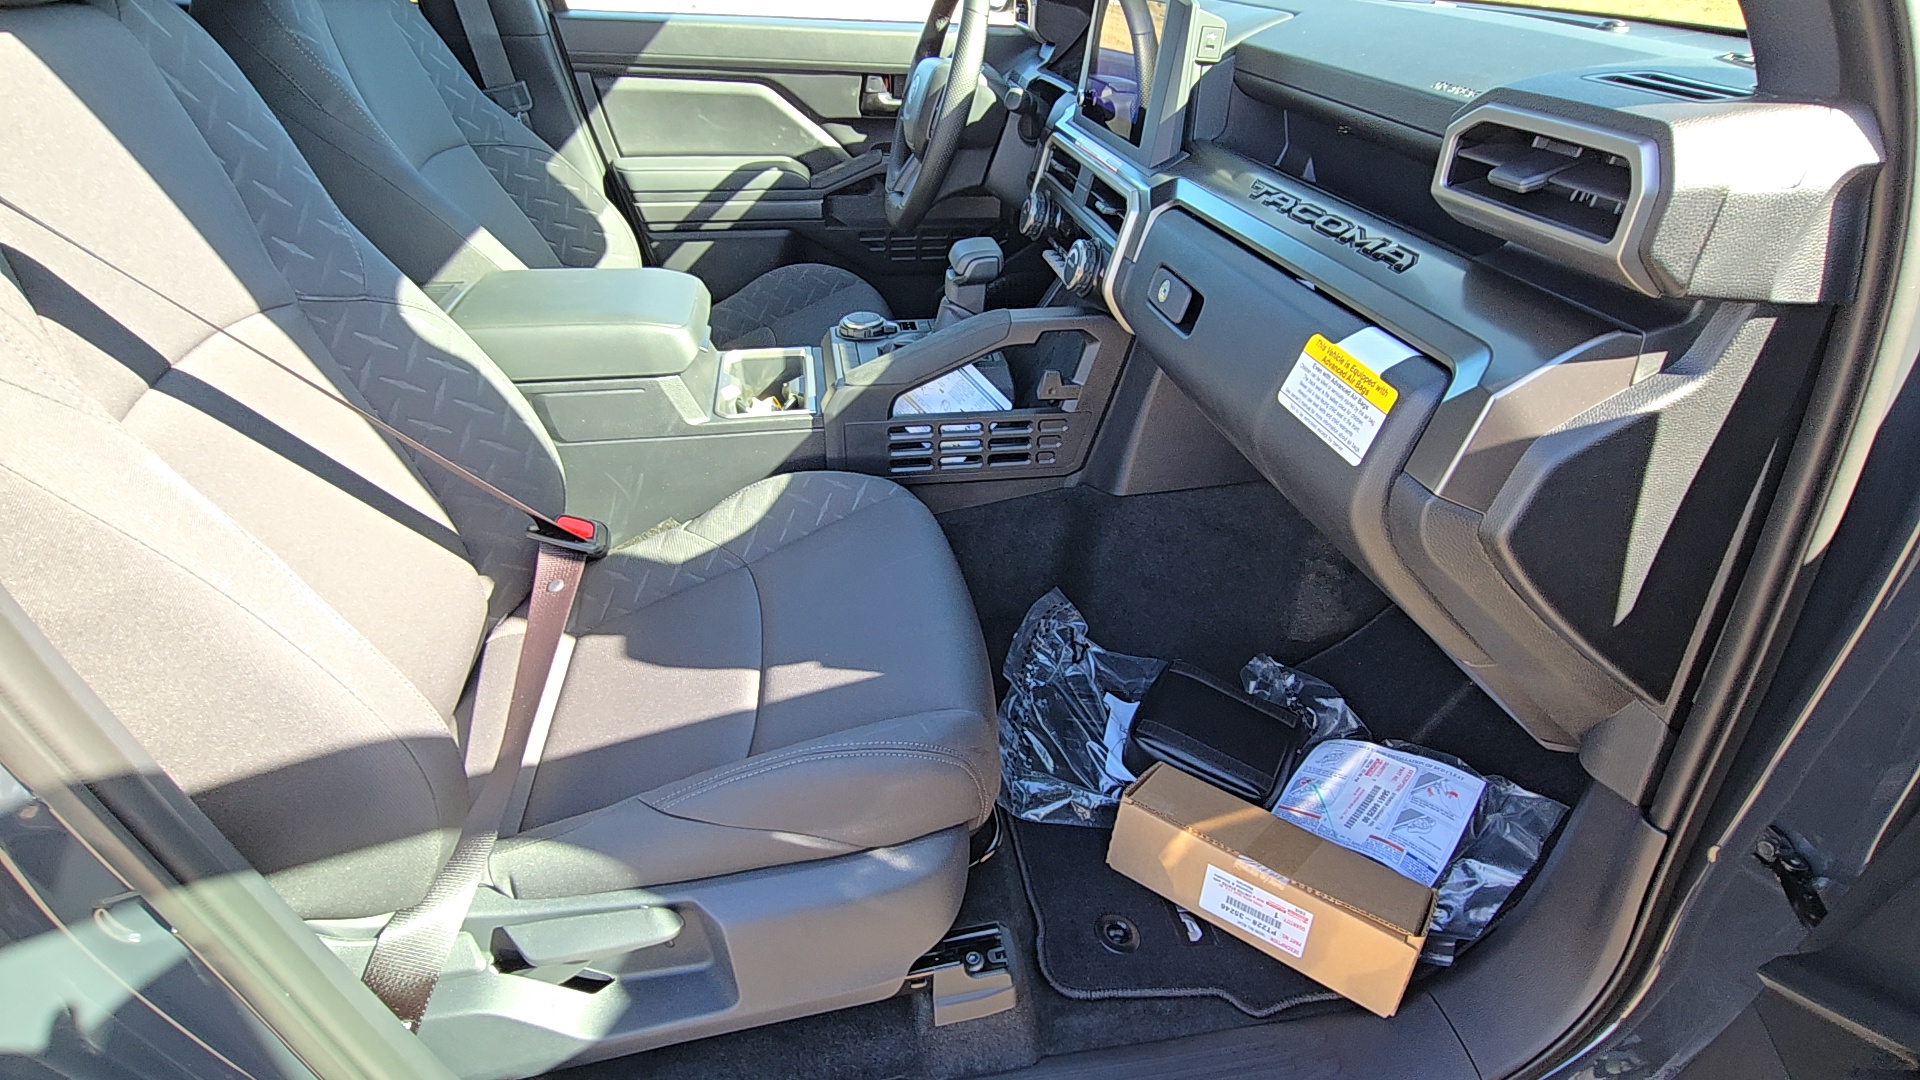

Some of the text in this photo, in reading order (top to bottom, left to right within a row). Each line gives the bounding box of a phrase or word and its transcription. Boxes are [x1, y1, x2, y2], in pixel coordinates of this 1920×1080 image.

[1249, 179, 1420, 274] TACOMA
[1315, 338, 1389, 397] This Vehicle is Equipped with
[1321, 354, 1370, 398] Advanced Air Bags
[1330, 376, 1351, 396] Advanced
[1273, 911, 1279, 919] 1
